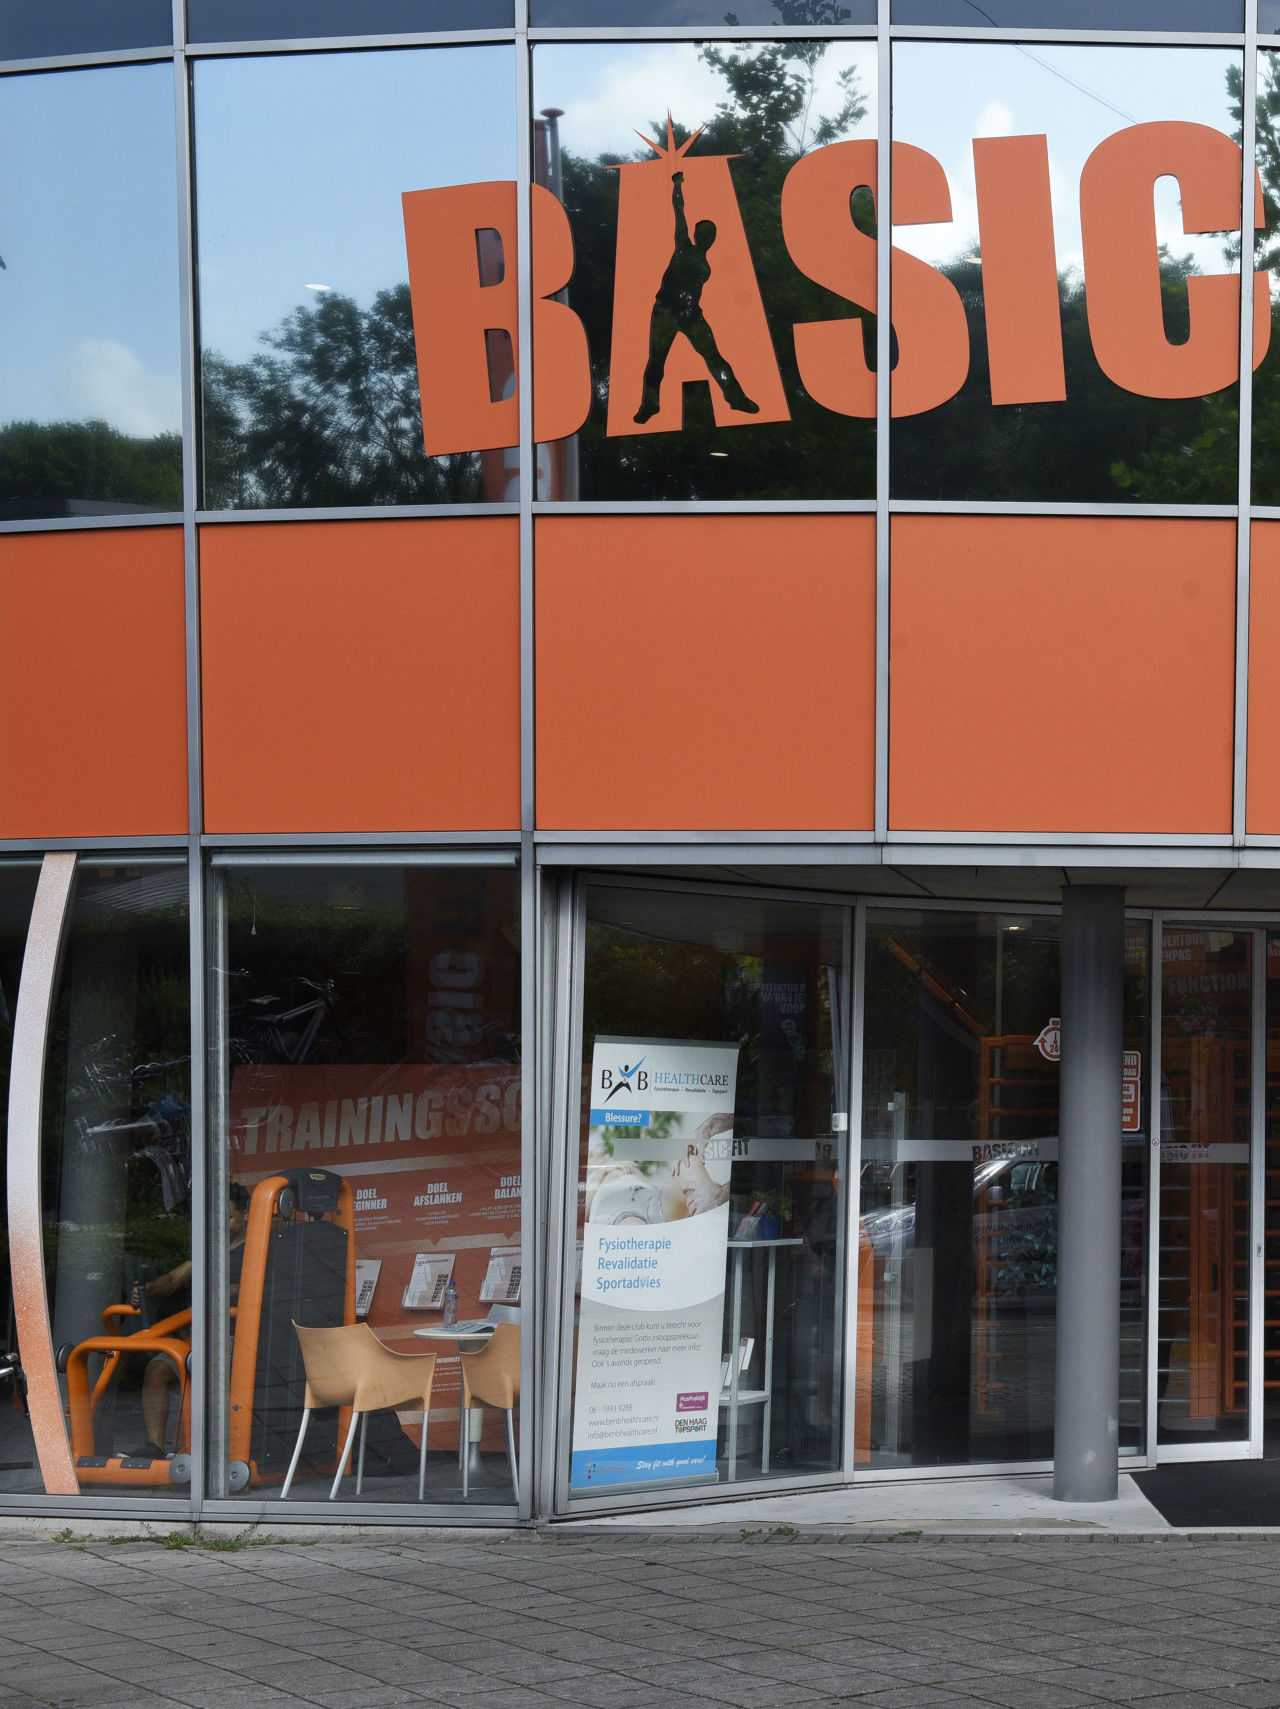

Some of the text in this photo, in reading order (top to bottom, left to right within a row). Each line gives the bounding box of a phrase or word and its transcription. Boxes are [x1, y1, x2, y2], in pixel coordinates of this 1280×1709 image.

[654, 1072, 729, 1086] HEALTHCARE
[605, 1112, 642, 1124] Blessure?
[356, 1188, 377, 1200] DOEL
[427, 1182, 448, 1194] DOEL
[414, 1192, 463, 1207] AFSLANKEN
[598, 1237, 672, 1253] Fysiotherapie
[597, 1257, 658, 1270] Revalidatie
[596, 1276, 661, 1292] Sportadvies
[631, 1323, 646, 1331] club
[646, 1322, 660, 1330] kunt
[666, 1321, 687, 1329] terecht
[633, 1334, 651, 1343] Gratis
[592, 1349, 609, 1357] vraag
[611, 1347, 619, 1355] de
[620, 1346, 657, 1355] medewerker
[592, 1360, 604, 1368] Ook
[610, 1358, 632, 1367] avonds
[590, 1381, 607, 1389] Maak
[675, 1418, 708, 1427] DEN HAAG
[675, 1425, 706, 1434] TOPSPORT
[636, 1460, 652, 1470] Stay
[652, 1459, 661, 1471] fit
[662, 1457, 675, 1466] with
[676, 1458, 689, 1468] good
